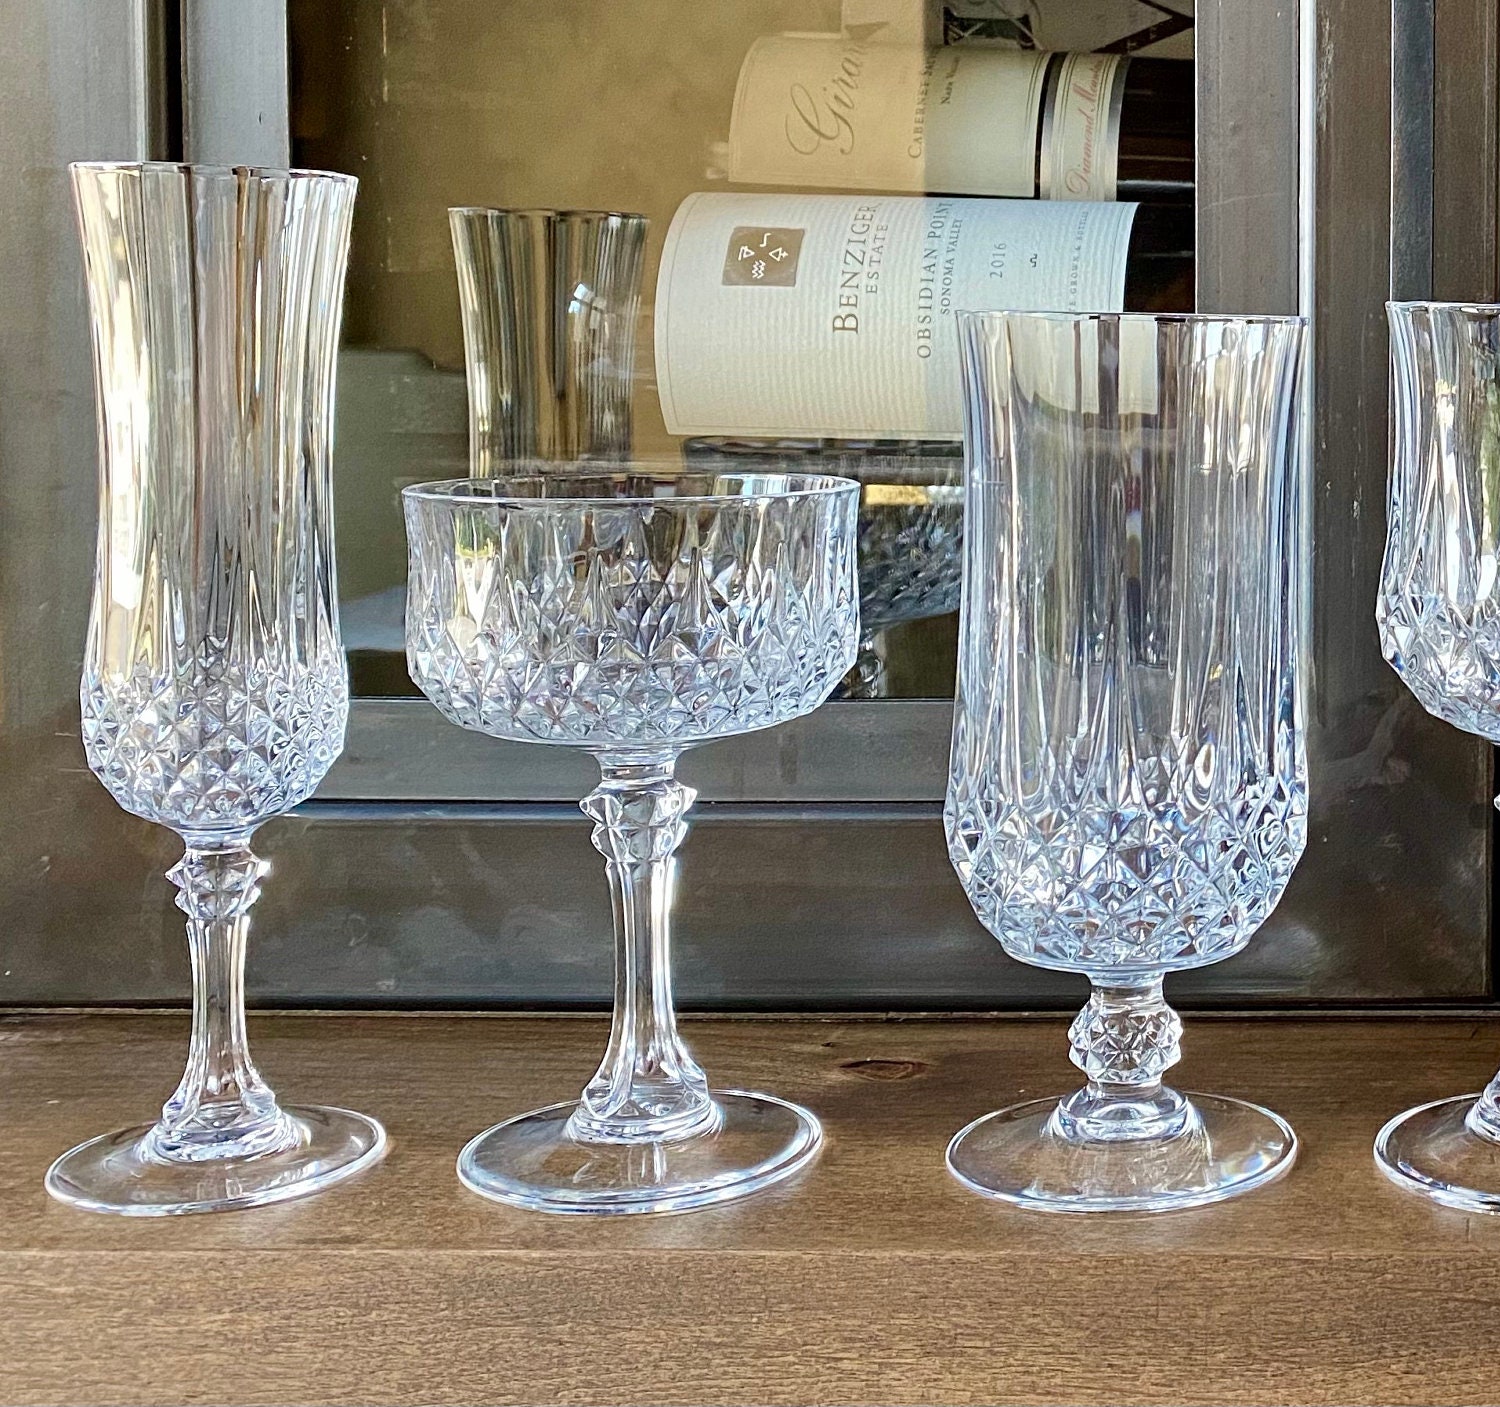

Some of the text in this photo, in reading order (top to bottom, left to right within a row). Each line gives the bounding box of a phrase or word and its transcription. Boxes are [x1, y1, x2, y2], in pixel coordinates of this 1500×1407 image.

[907, 81, 931, 159] CABERNET
[1065, 107, 1094, 194] Diamond
[832, 202, 882, 334] BENZIGER
[865, 223, 889, 295] ESTATE
[916, 201, 953, 359] OBSIDIAN POINT
[940, 218, 963, 316] SONOMA VALLEY
[989, 242, 1007, 279] 2016
